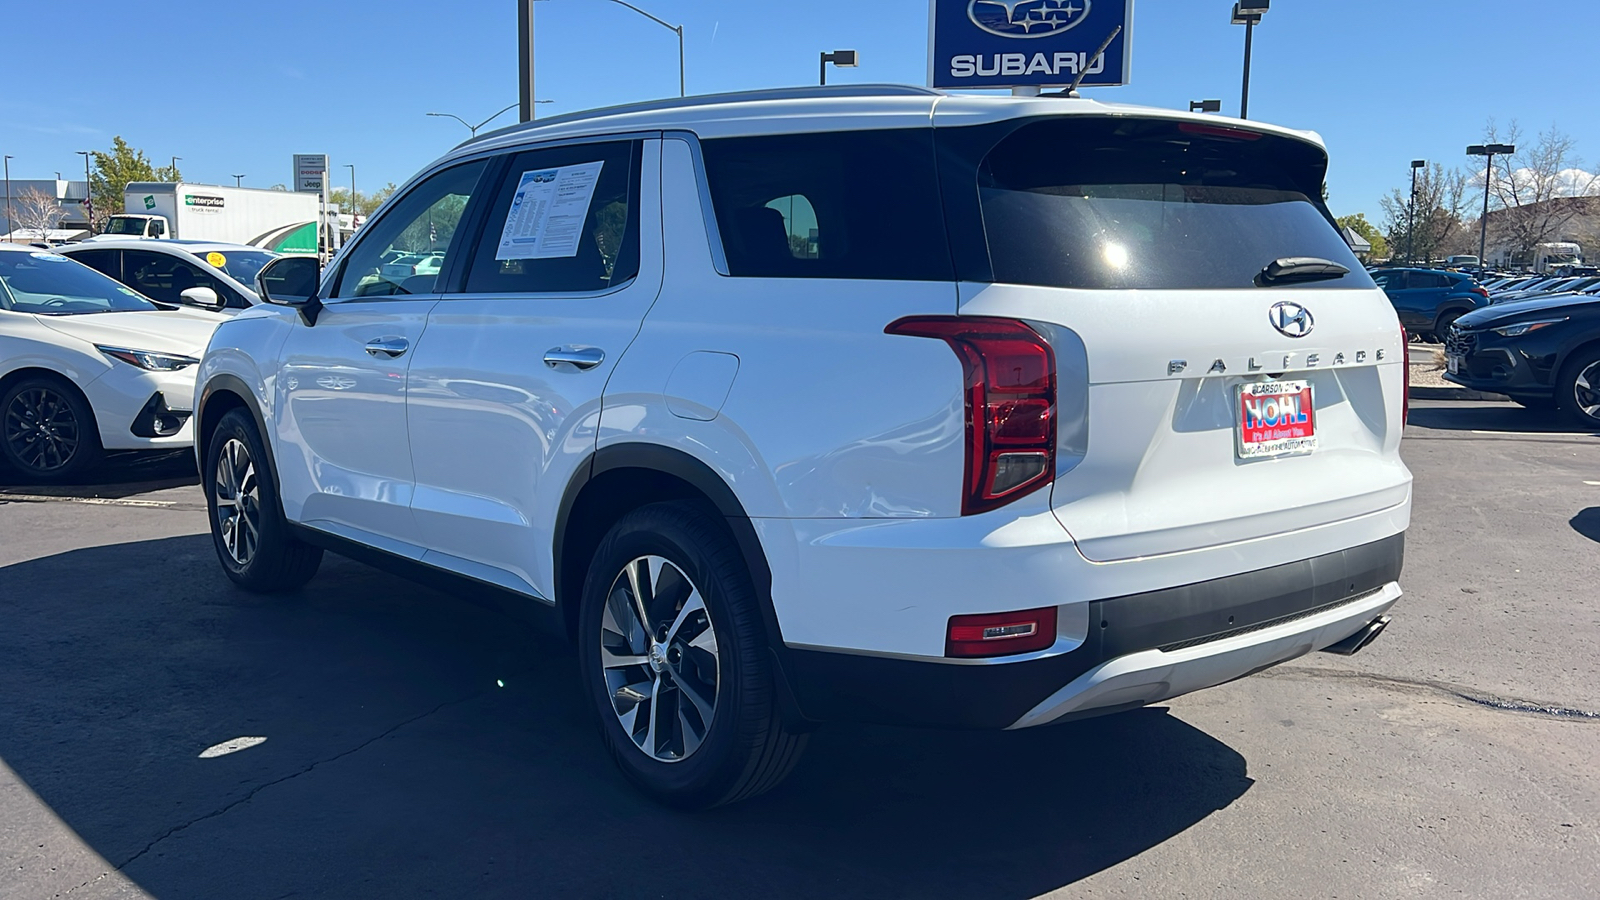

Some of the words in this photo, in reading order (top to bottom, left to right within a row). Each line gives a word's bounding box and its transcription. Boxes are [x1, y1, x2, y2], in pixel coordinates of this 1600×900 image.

[951, 52, 1104, 77] SUBARU
[304, 180, 321, 188] Jeep
[187, 195, 224, 206] enterprise
[1167, 348, 1385, 376] PALISADE
[1256, 383, 1282, 394] CARSON
[1245, 395, 1307, 429] HOHL
[1253, 432, 1262, 441] It's
[1263, 429, 1272, 439] All
[1273, 428, 1292, 439] About
